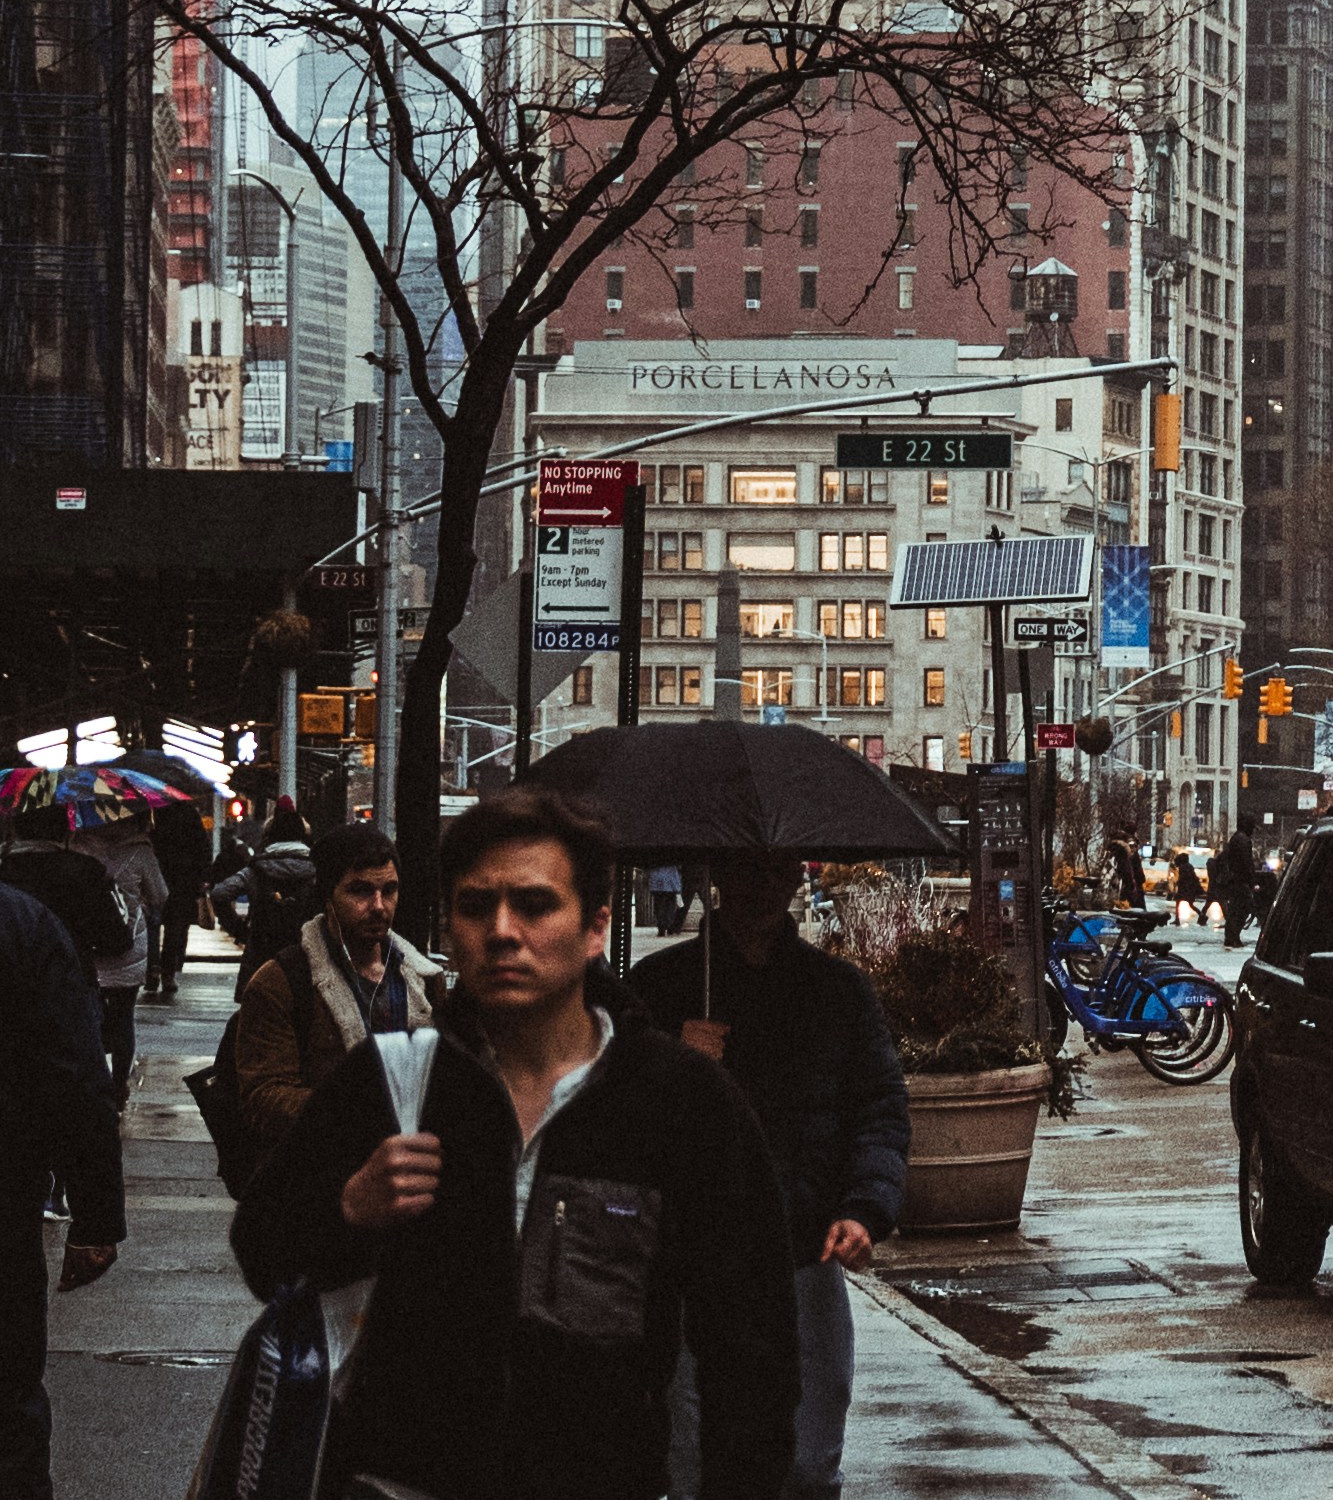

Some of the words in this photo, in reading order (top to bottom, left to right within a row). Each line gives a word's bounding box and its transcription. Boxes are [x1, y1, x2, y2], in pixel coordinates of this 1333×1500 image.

[631, 364, 896, 389] PORCELANOSA
[882, 440, 893, 462] E
[906, 440, 932, 462] 22
[944, 439, 966, 462] St
[544, 467, 561, 479] NO
[564, 467, 622, 479] STOPPING
[544, 481, 593, 496] Anytime
[546, 527, 561, 552] 2
[572, 537, 605, 545] metered
[571, 547, 600, 556] parking
[541, 565, 561, 575] 9am
[570, 565, 590, 576] 7pm
[321, 572, 326, 586] E
[333, 572, 347, 586] 22
[353, 572, 365, 586] St
[541, 577, 572, 588] Except
[574, 577, 607, 589] Sunday
[1020, 625, 1044, 634] ONE
[1056, 625, 1079, 634] WAY
